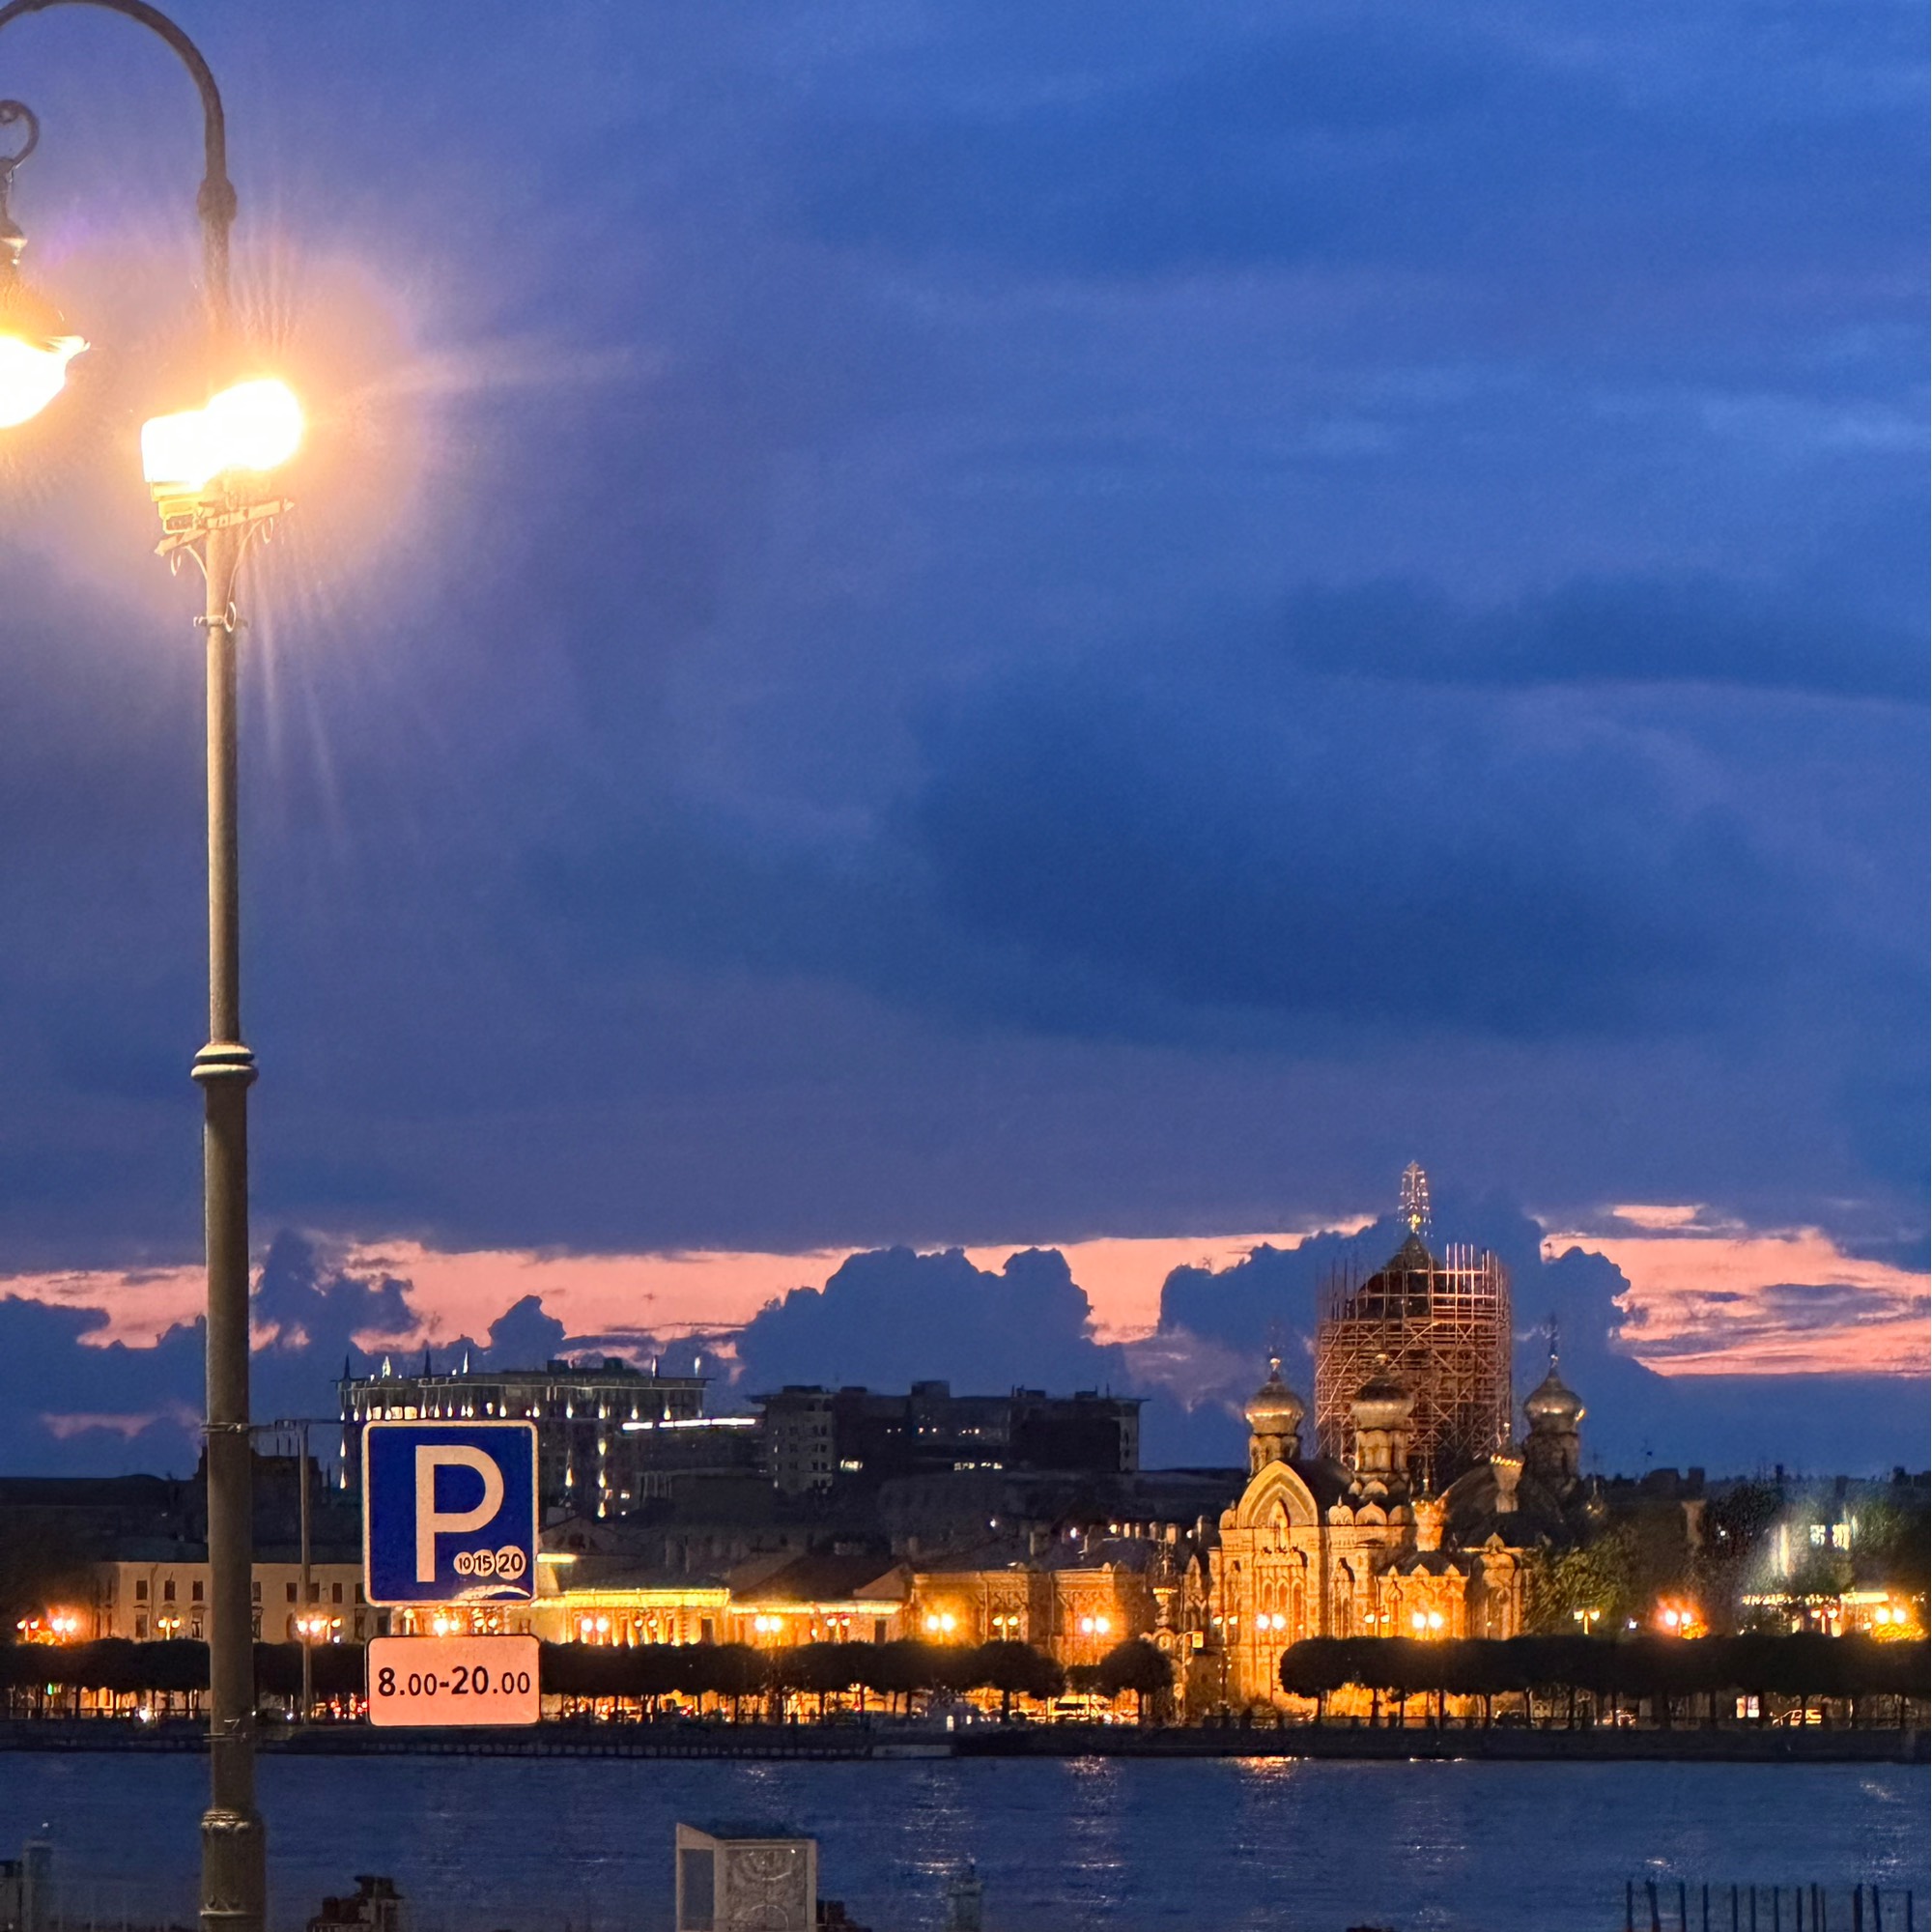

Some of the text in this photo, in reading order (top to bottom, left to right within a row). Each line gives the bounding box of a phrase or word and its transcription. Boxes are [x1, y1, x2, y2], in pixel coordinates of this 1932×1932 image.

[415, 1445, 504, 1582] P
[459, 1553, 524, 1573] 10 15 20
[378, 1665, 530, 1696] 8.00-20.00
